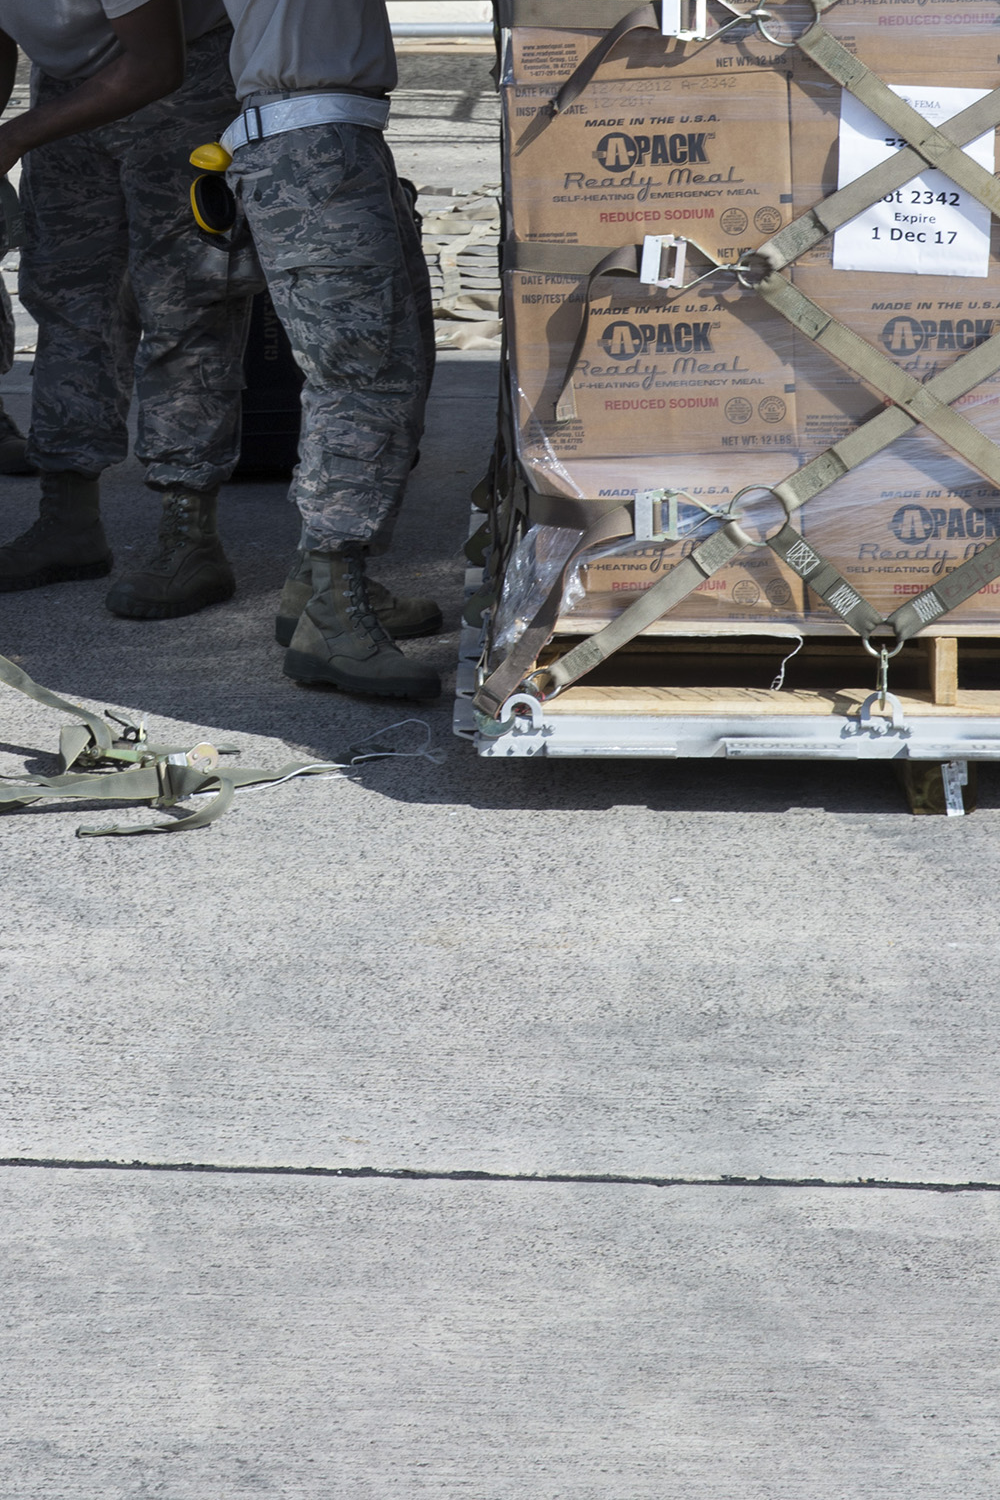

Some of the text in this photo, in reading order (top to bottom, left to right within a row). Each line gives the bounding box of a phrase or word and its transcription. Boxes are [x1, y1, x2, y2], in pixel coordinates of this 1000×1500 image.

[879, 15, 941, 26] REDUCED
[716, 58, 738, 68] NET
[769, 55, 787, 65] LBS
[516, 89, 536, 97] DATE
[915, 101, 941, 109] FEMA
[564, 167, 744, 202] Ready Meal
[553, 194, 634, 203] SELF-HEATING
[650, 189, 723, 199] EMERGENCY
[911, 191, 960, 206] 2342
[600, 209, 714, 222] REDUCED SODIUM
[895, 213, 936, 224] Expire
[872, 227, 957, 244] 1 Dec 17
[717, 248, 734, 258] NET
[521, 276, 542, 285] DATE
[590, 307, 629, 315] MADE
[655, 305, 680, 313] THE
[685, 304, 725, 312] U.S.A.
[673, 357, 749, 374] Meal
[655, 379, 727, 387] EMERGENCY
[605, 397, 719, 410] REDUCED SODIUM
[722, 435, 792, 446] NET WT: 12 LBS
[858, 543, 958, 575] Ready
